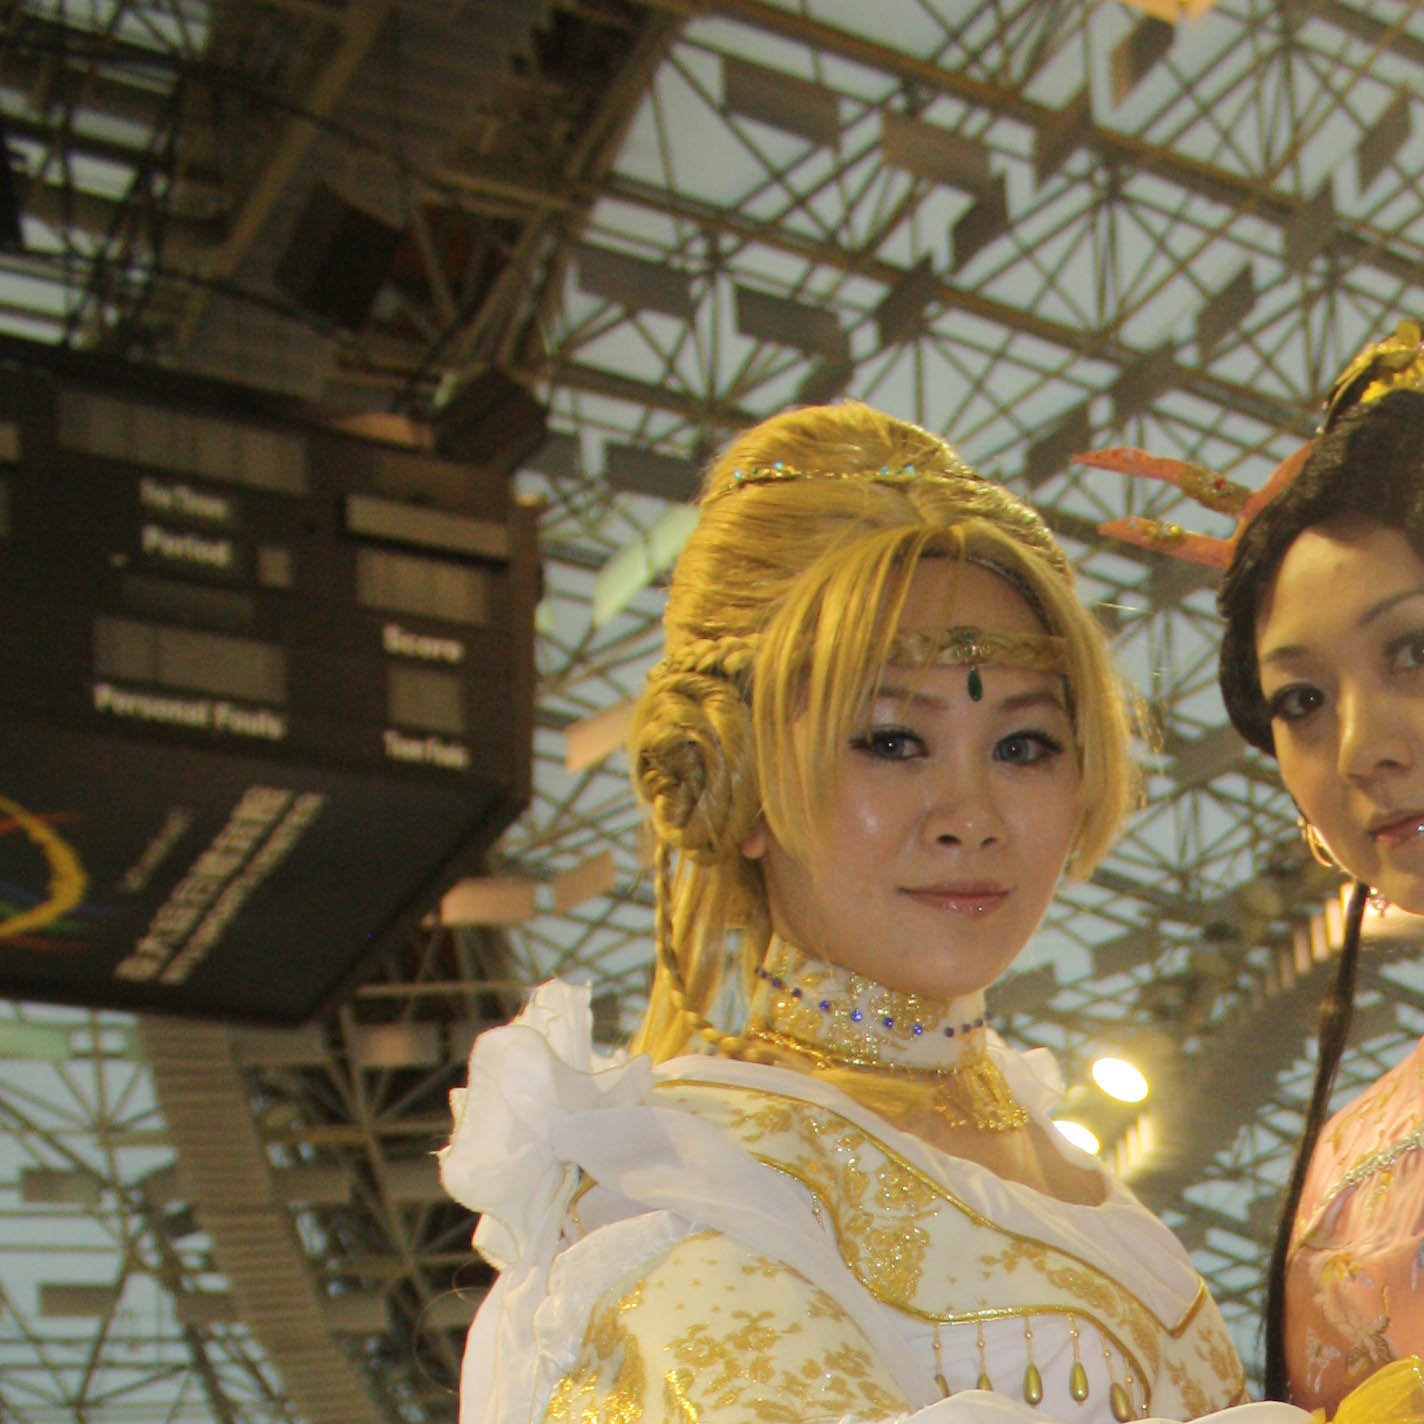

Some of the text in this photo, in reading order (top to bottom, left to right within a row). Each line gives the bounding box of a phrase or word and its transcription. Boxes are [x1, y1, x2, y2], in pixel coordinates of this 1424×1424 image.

[141, 524, 233, 567] Period
[382, 623, 465, 665] Score
[93, 682, 211, 730] Personal
